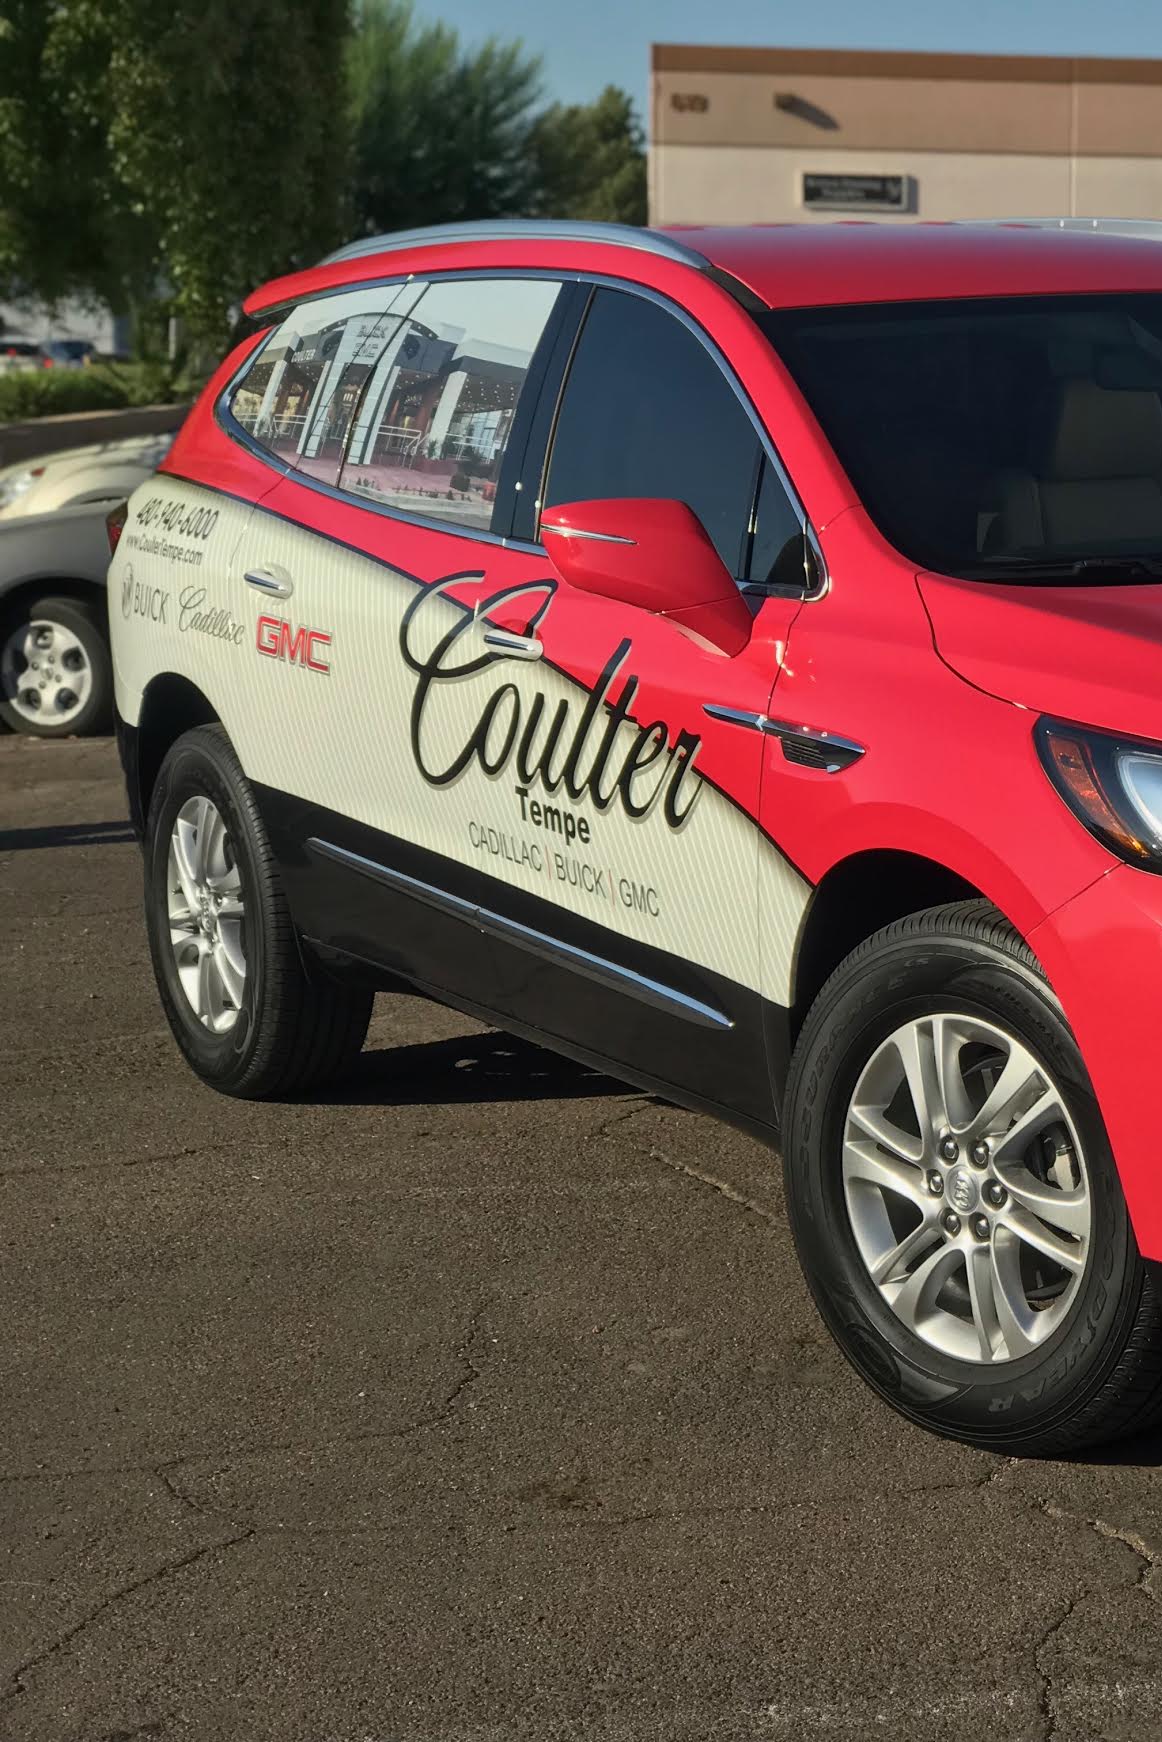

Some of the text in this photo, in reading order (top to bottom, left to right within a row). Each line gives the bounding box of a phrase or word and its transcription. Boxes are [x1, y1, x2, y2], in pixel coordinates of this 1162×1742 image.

[136, 498, 219, 540] 480-940-6000
[126, 533, 203, 566] www.CoulterTempe.com
[134, 581, 170, 624] BUICK
[178, 585, 244, 645] Cadillac
[256, 612, 332, 675] GMC
[400, 570, 703, 833] Coulter
[515, 786, 590, 845] Tempe
[468, 821, 660, 917] CADILLAC BUICK GMC
